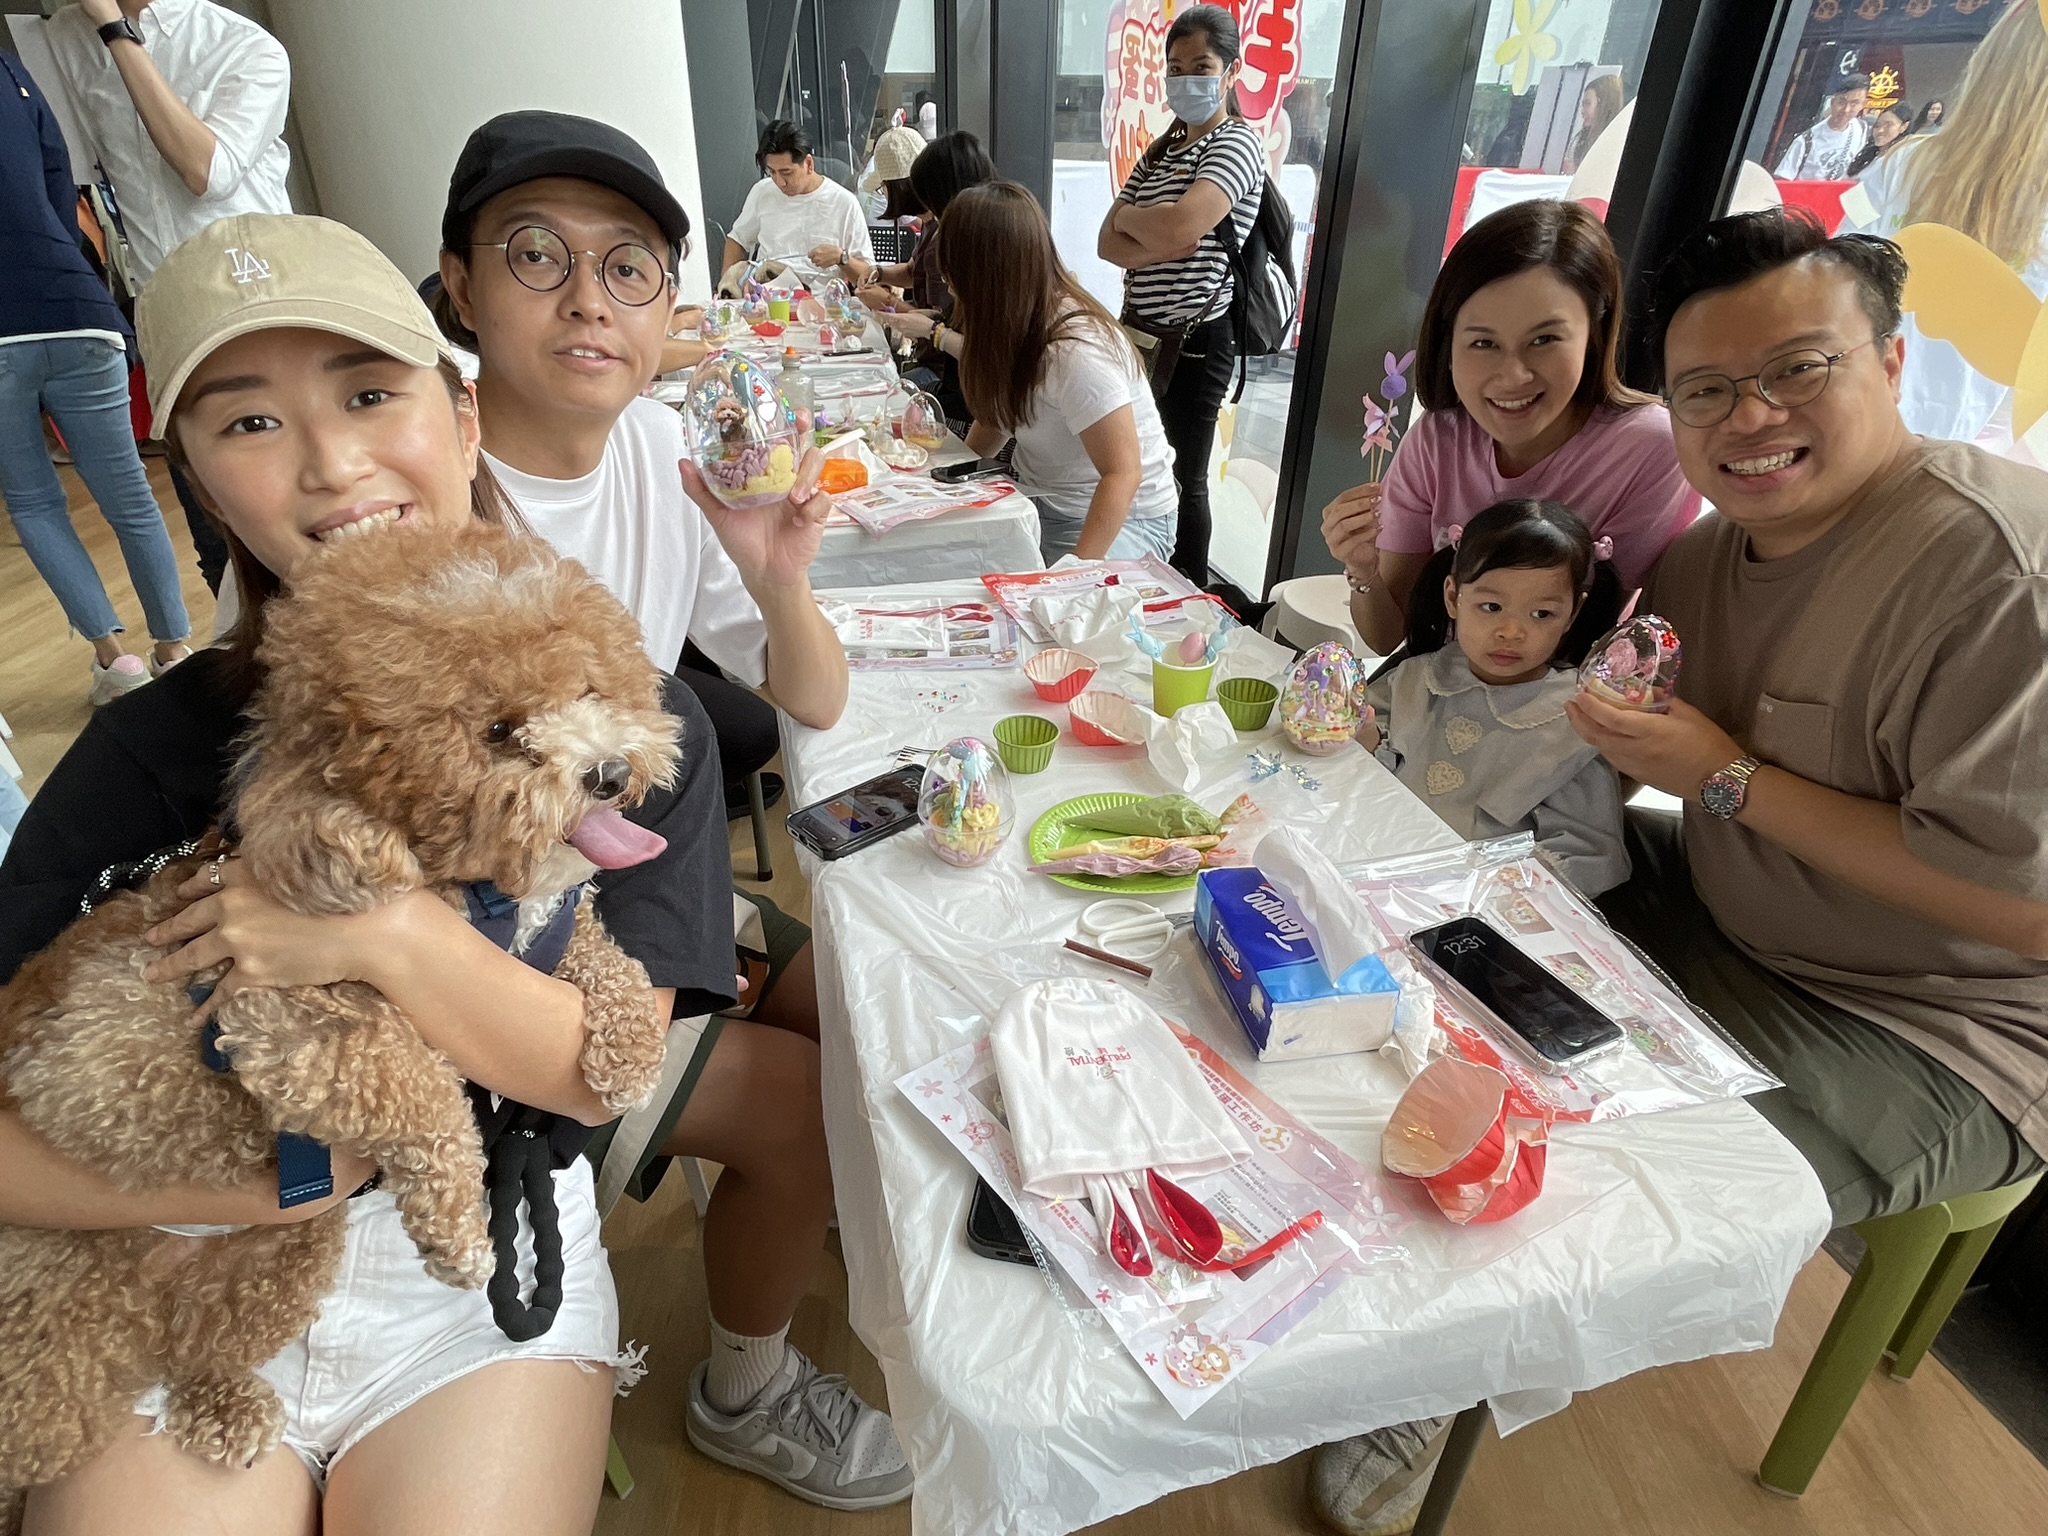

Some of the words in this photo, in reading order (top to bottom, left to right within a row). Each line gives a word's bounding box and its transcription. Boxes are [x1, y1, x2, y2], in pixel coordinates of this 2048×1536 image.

[224, 248, 272, 284] LA
[1243, 889, 1309, 952] Tempo
[1215, 920, 1241, 968] Tempo
[1443, 935, 1487, 956] 12:31
[1066, 1051, 1132, 1066] PRUDENTIAL
